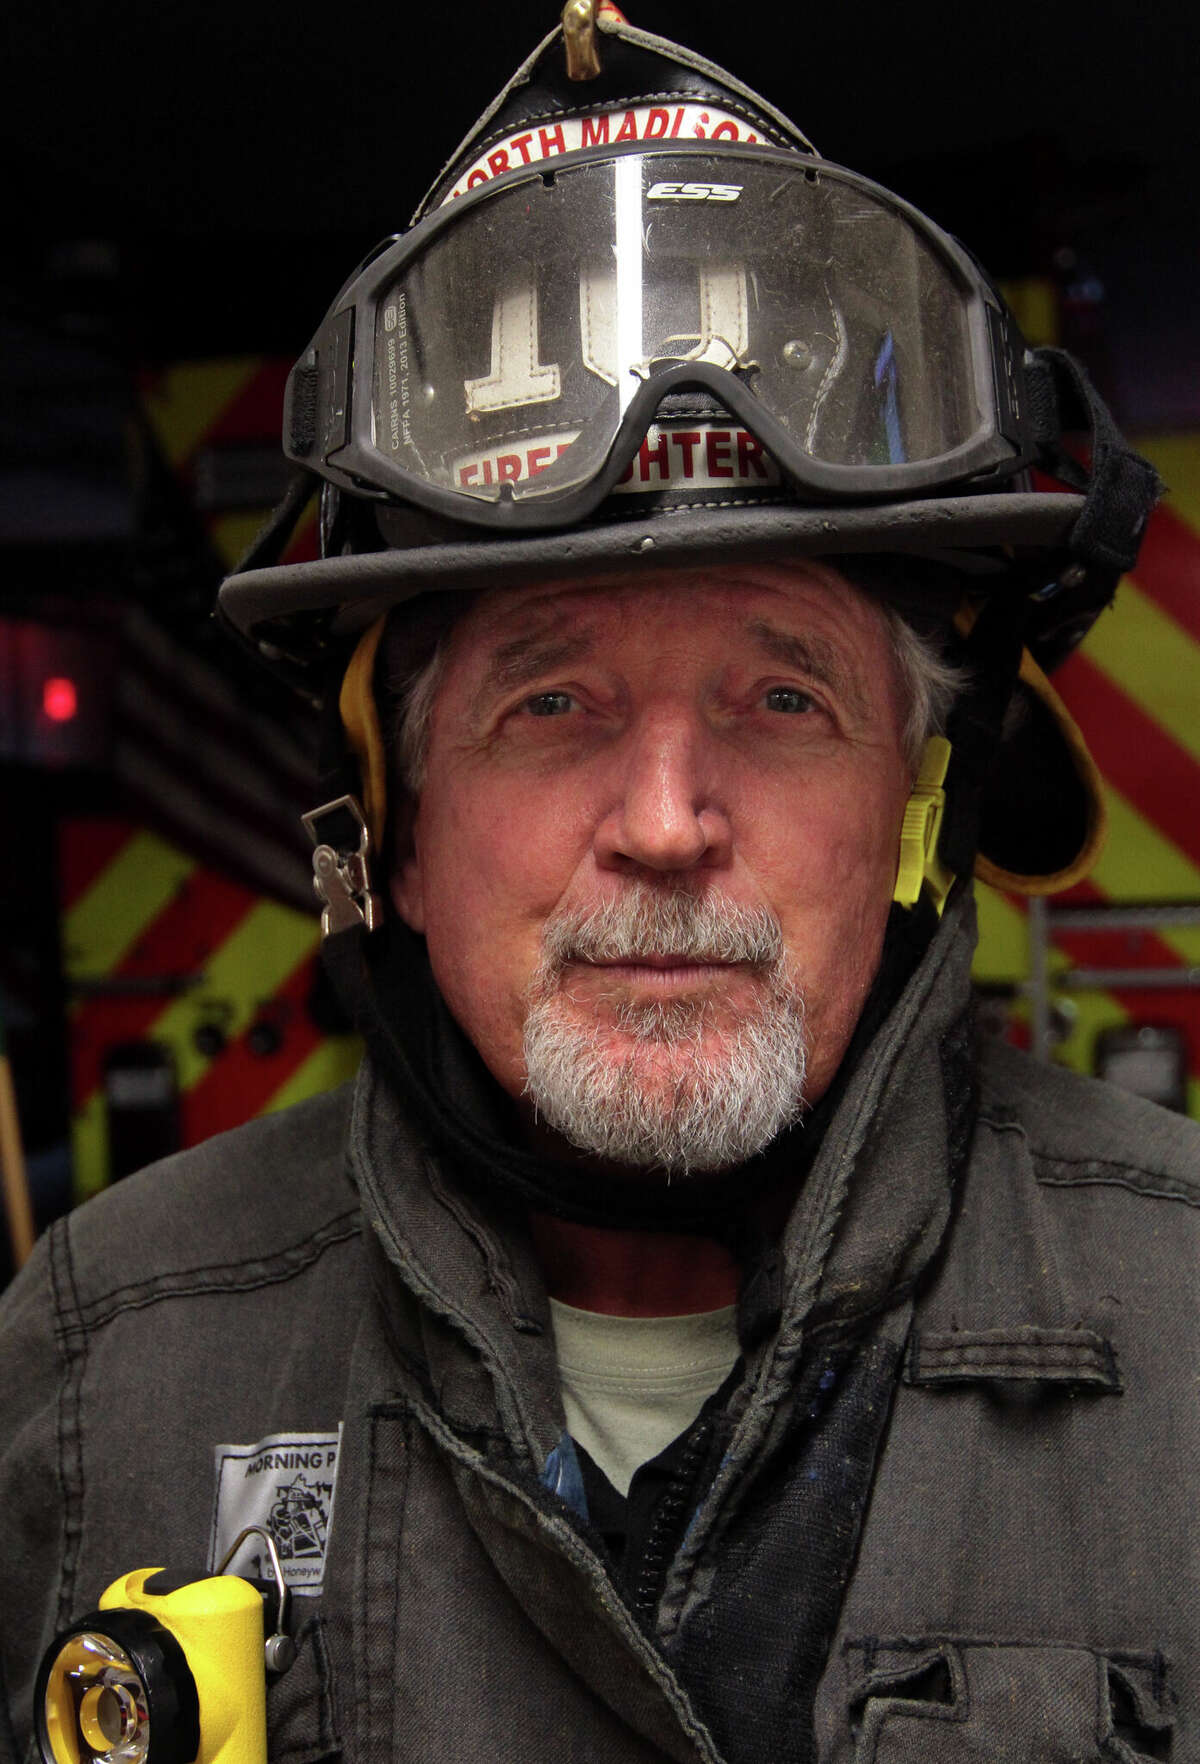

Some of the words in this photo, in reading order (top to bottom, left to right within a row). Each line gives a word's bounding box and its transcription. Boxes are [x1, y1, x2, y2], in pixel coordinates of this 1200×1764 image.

[453, 124, 566, 198] ORTH
[581, 107, 757, 148] MADISO
[647, 183, 744, 202] ESS
[399, 293, 408, 339] Edition
[400, 341, 409, 371] 2013
[390, 400, 399, 450] CAIRNS
[459, 432, 769, 486] FIREHTER
[245, 1452, 322, 1478] MORNING
